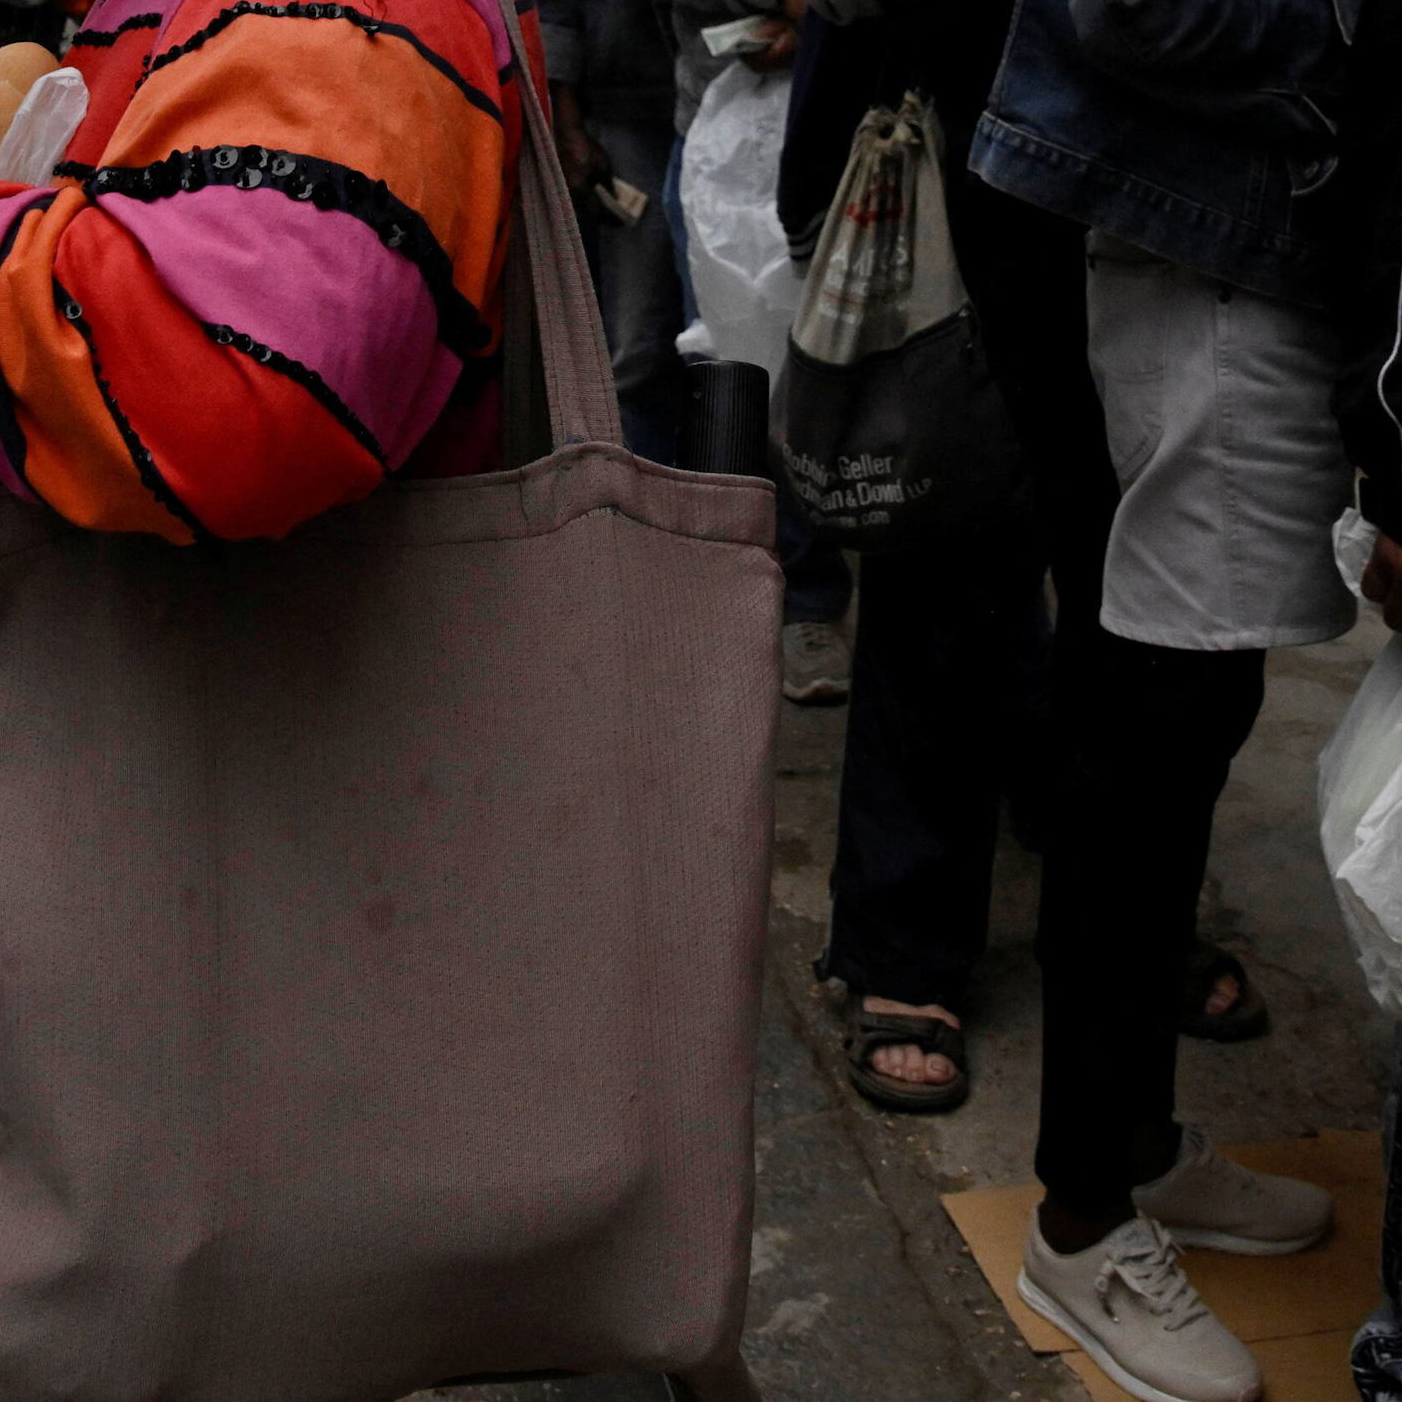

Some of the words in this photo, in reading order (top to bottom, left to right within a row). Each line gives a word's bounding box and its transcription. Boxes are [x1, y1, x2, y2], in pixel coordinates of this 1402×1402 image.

[838, 452, 894, 480] Geller
[845, 489, 858, 507] &
[856, 477, 906, 505] Dowd
[906, 478, 933, 499] LLP
